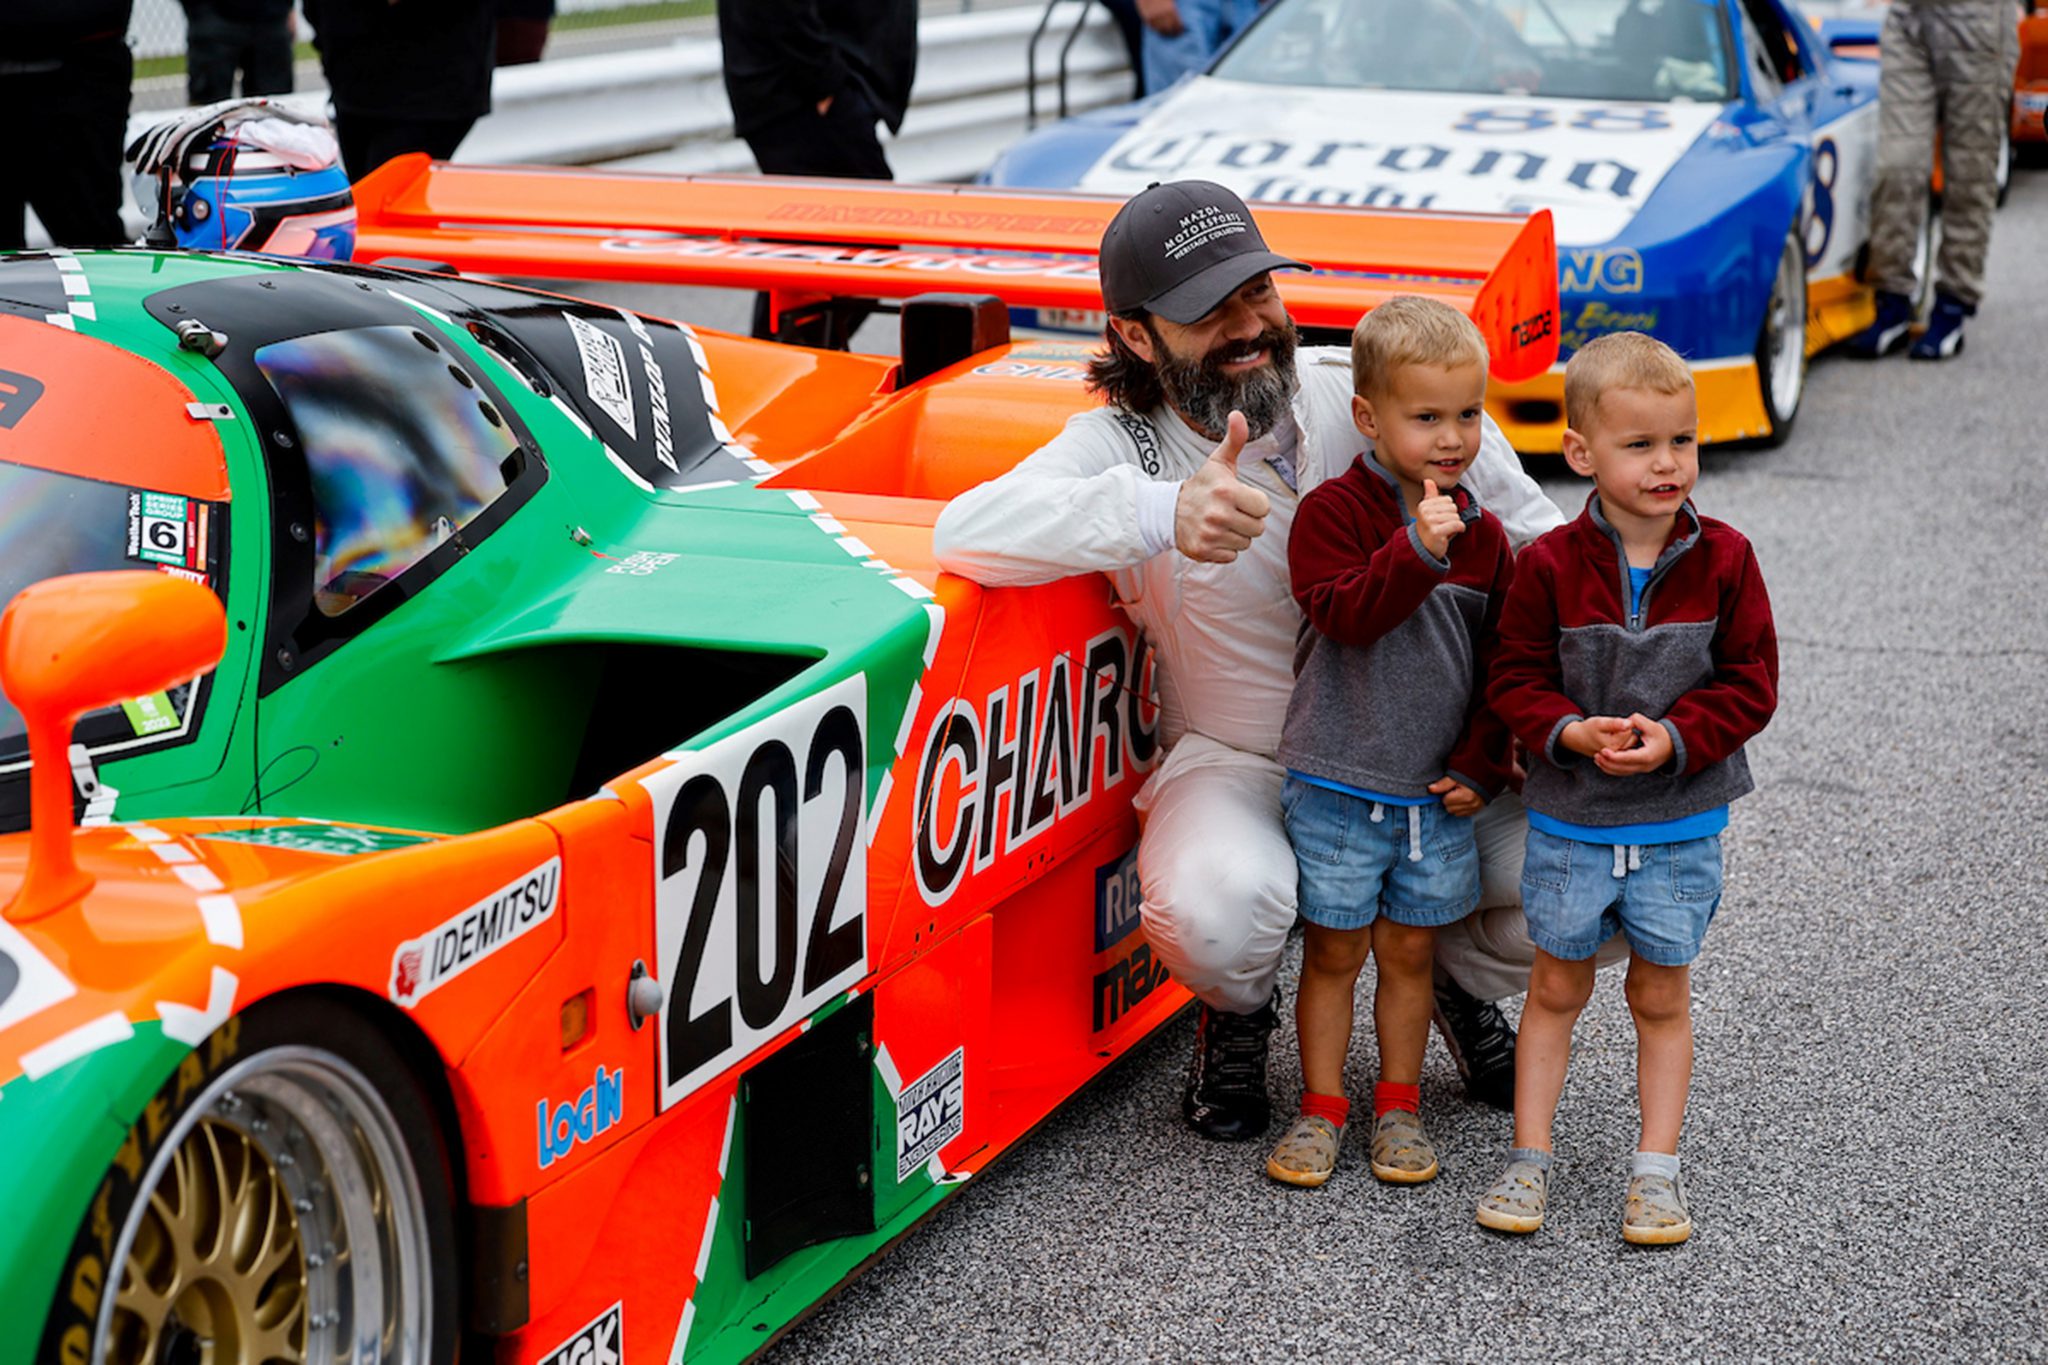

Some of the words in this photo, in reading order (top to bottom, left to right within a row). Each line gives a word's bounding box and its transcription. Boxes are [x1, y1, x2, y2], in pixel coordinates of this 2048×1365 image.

[1452, 105, 1673, 134] 88
[1110, 131, 1643, 199] Corona
[1164, 213, 1241, 250] MOTORSPORTS
[1173, 235, 1209, 260] HERITAGE
[1208, 226, 1246, 241] COLLECTION
[1179, 206, 1221, 228] MAZDA
[638, 343, 681, 474] DUNLOP
[149, 521, 178, 549] 6
[430, 866, 557, 981] IDEMITSU
[662, 704, 866, 1088] 202
[898, 1081, 962, 1158] RAYS
[899, 1114, 962, 1173] ENGINEERING
